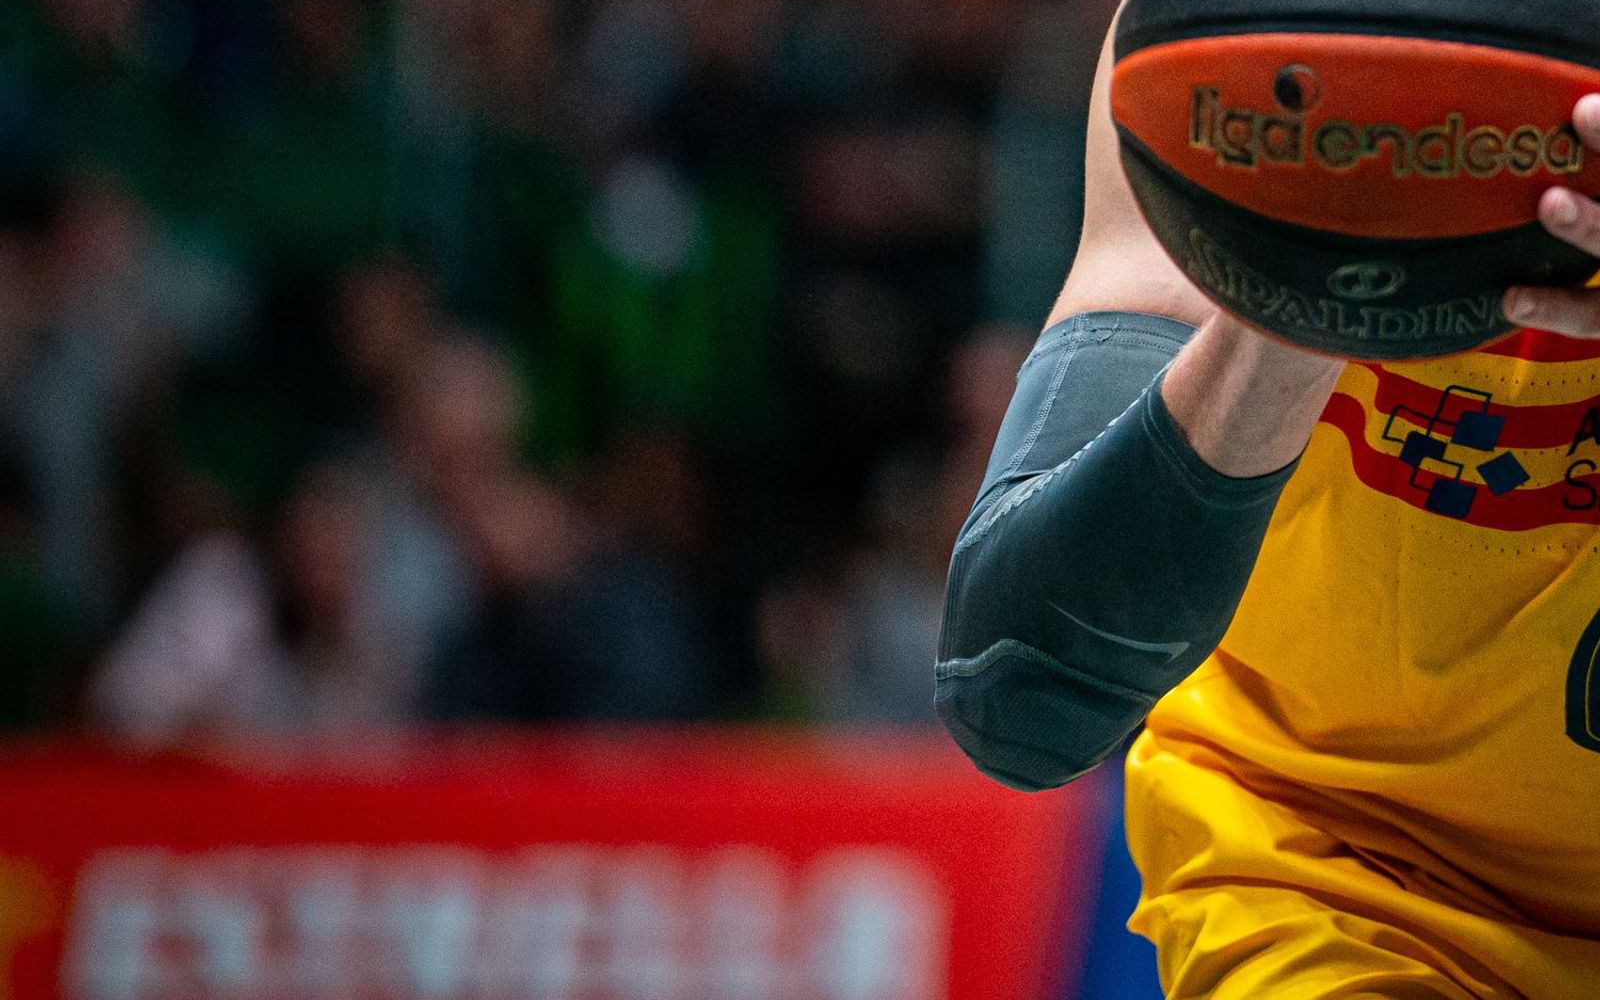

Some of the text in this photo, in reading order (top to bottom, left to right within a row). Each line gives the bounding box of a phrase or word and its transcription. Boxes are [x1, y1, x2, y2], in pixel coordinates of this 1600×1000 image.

[1188, 85, 1582, 178] liga endesa
[1186, 225, 1502, 339] SPALDIN
